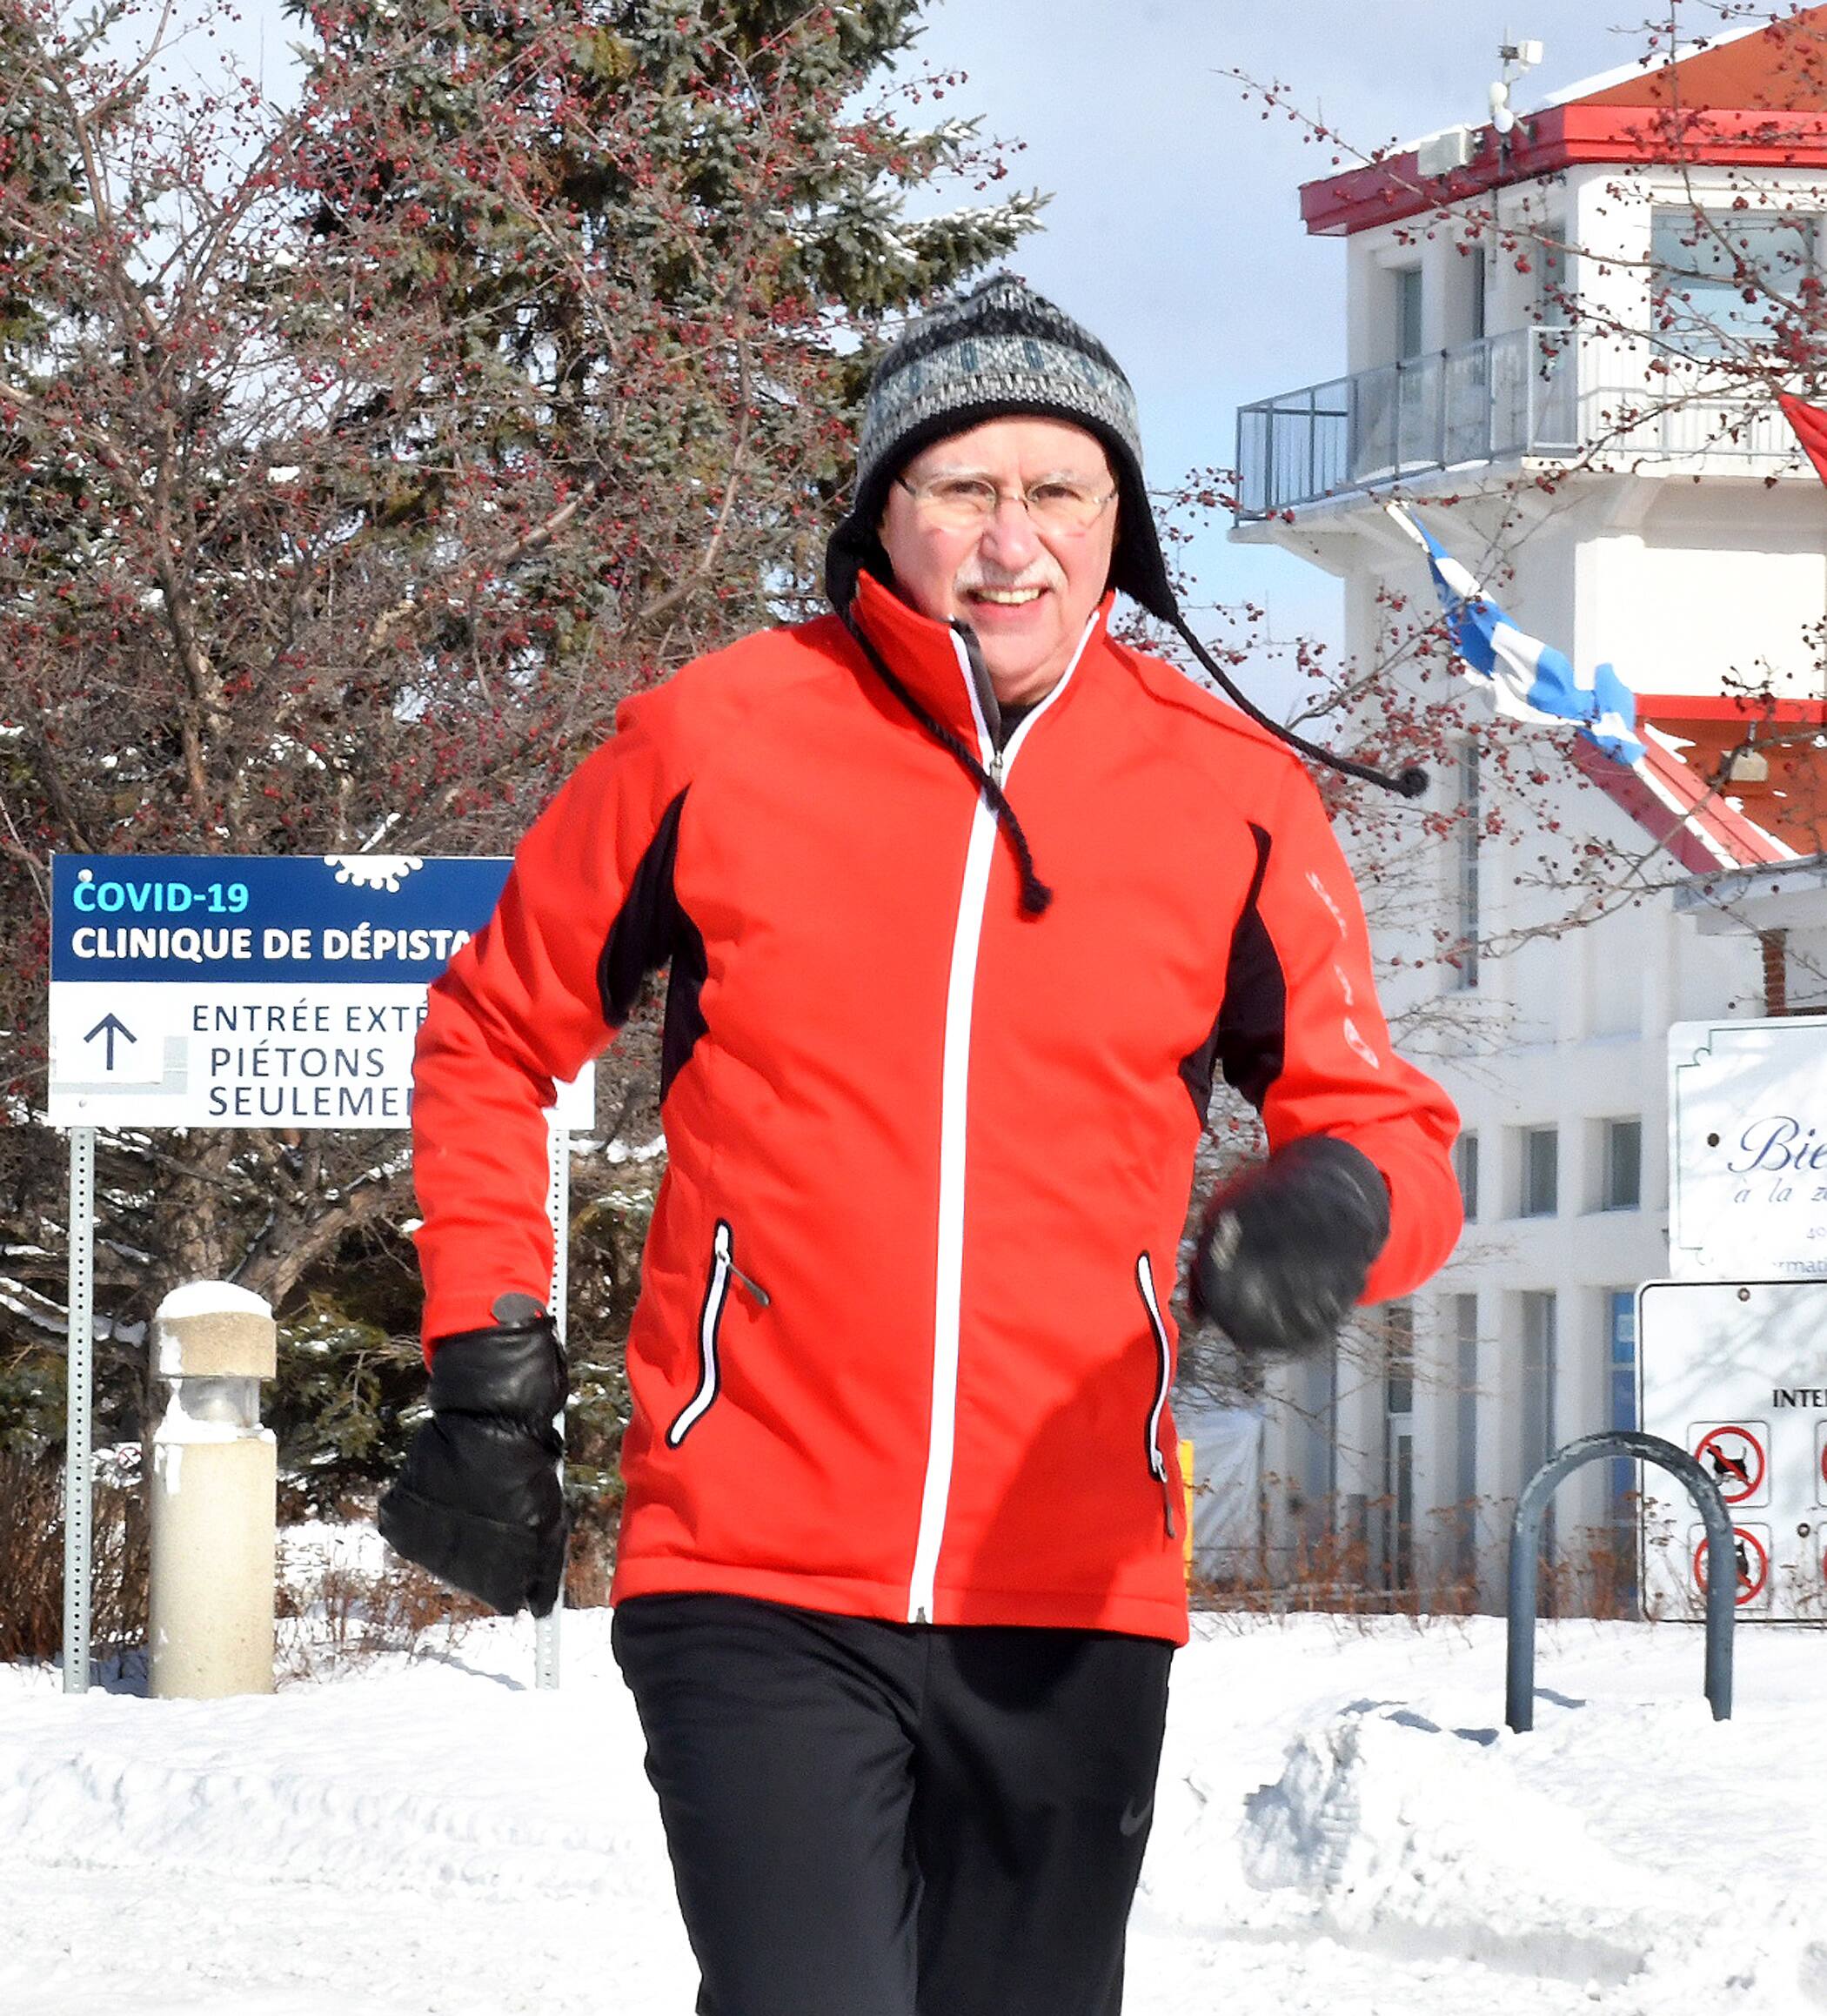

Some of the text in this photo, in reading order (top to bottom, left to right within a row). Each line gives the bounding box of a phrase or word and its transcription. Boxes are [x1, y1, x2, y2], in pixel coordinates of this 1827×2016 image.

[73, 881, 250, 913] COVID-19
[72, 922, 472, 964] CLINIQUE DE DÉPISTA
[193, 998, 331, 1033] ENTRÉE
[211, 1039, 385, 1078] PIÉTONS
[1768, 1177, 1793, 1203] la
[1772, 1388, 1827, 1408] INTE
